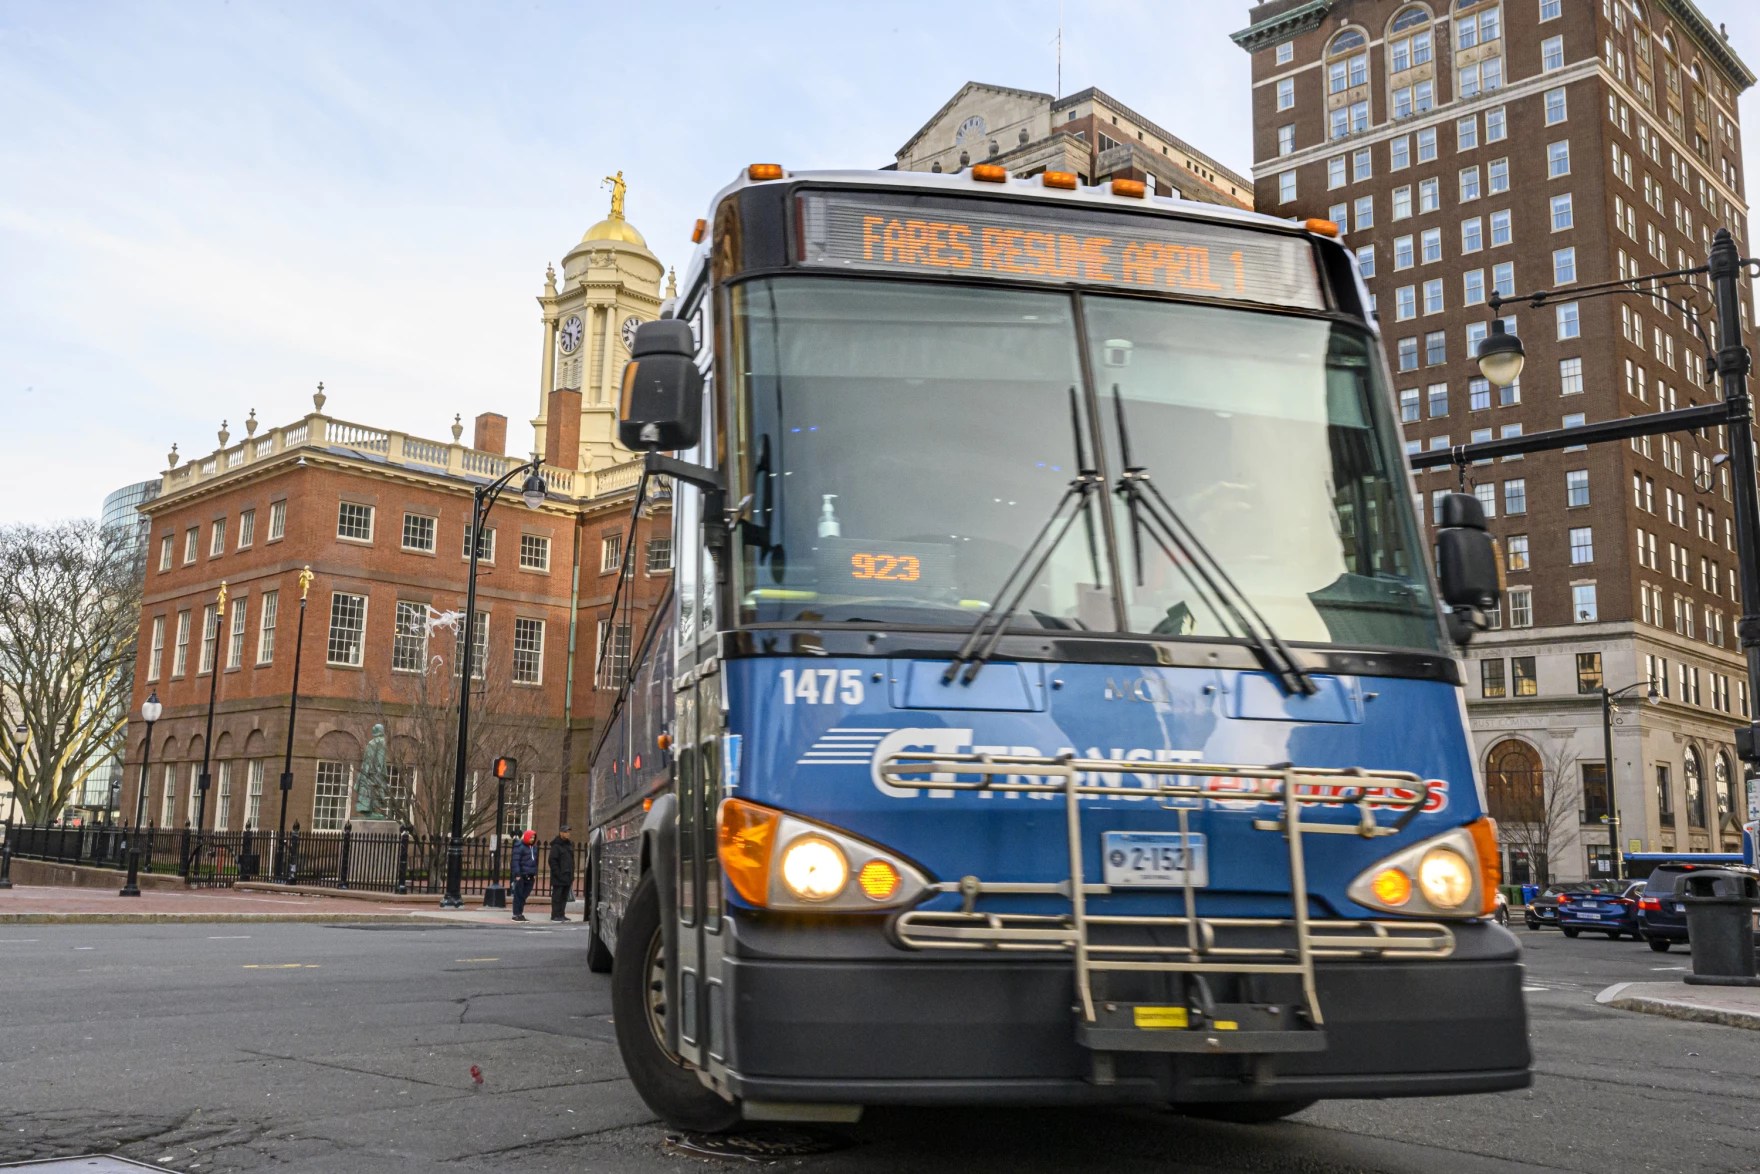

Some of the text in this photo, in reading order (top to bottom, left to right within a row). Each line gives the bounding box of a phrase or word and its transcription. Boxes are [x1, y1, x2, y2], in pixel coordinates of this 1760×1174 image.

[862, 216, 1245, 294] FARES RESUME APRIL 1
[851, 553, 921, 582] 923
[779, 668, 865, 705] 1475
[971, 745, 1204, 801] TRANSIT
